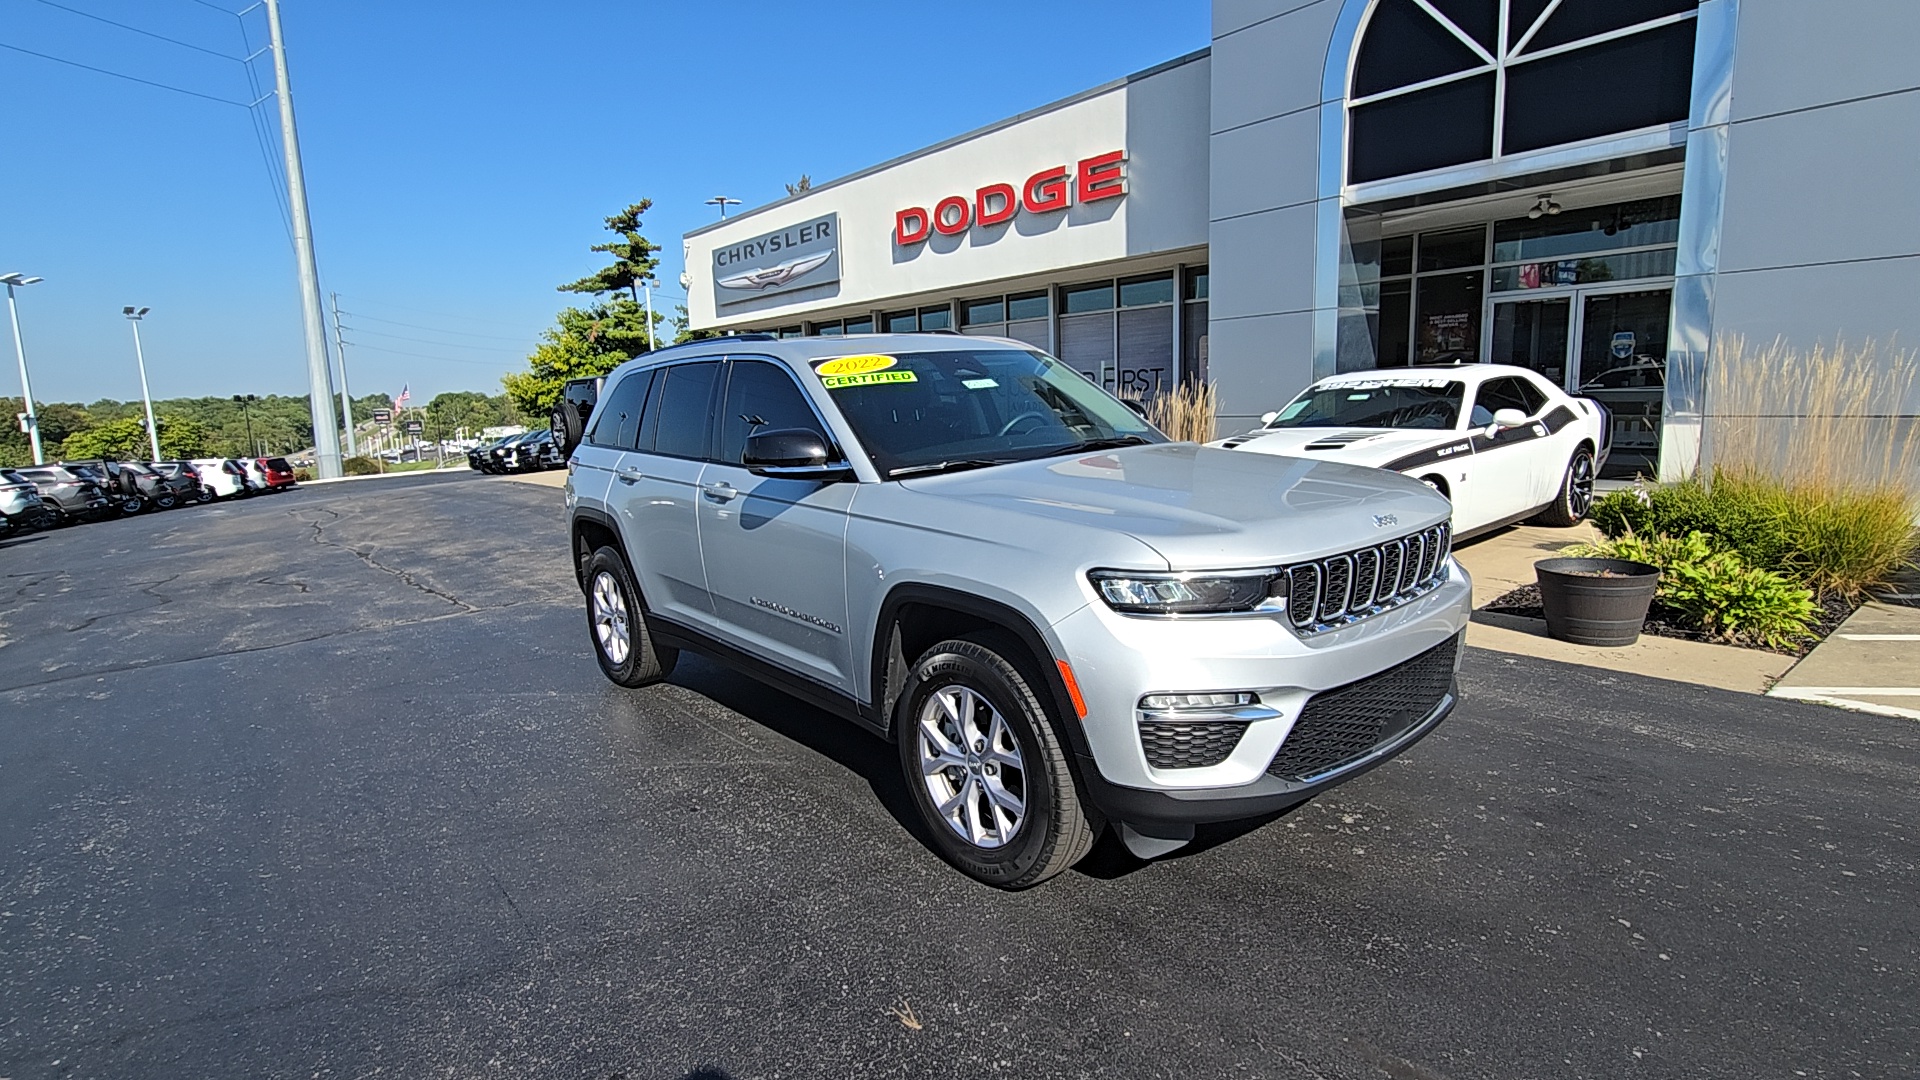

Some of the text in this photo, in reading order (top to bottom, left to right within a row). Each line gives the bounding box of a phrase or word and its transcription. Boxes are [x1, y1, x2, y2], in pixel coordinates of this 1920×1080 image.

[896, 149, 1126, 245] DODGE
[716, 221, 831, 267] CHRYSLER
[833, 357, 883, 373] 2022
[825, 372, 912, 387] CERTIFIED
[1380, 379, 1450, 388] HEMI
[1372, 513, 1398, 528] Jeep
[932, 662, 971, 674] MICHELIN
